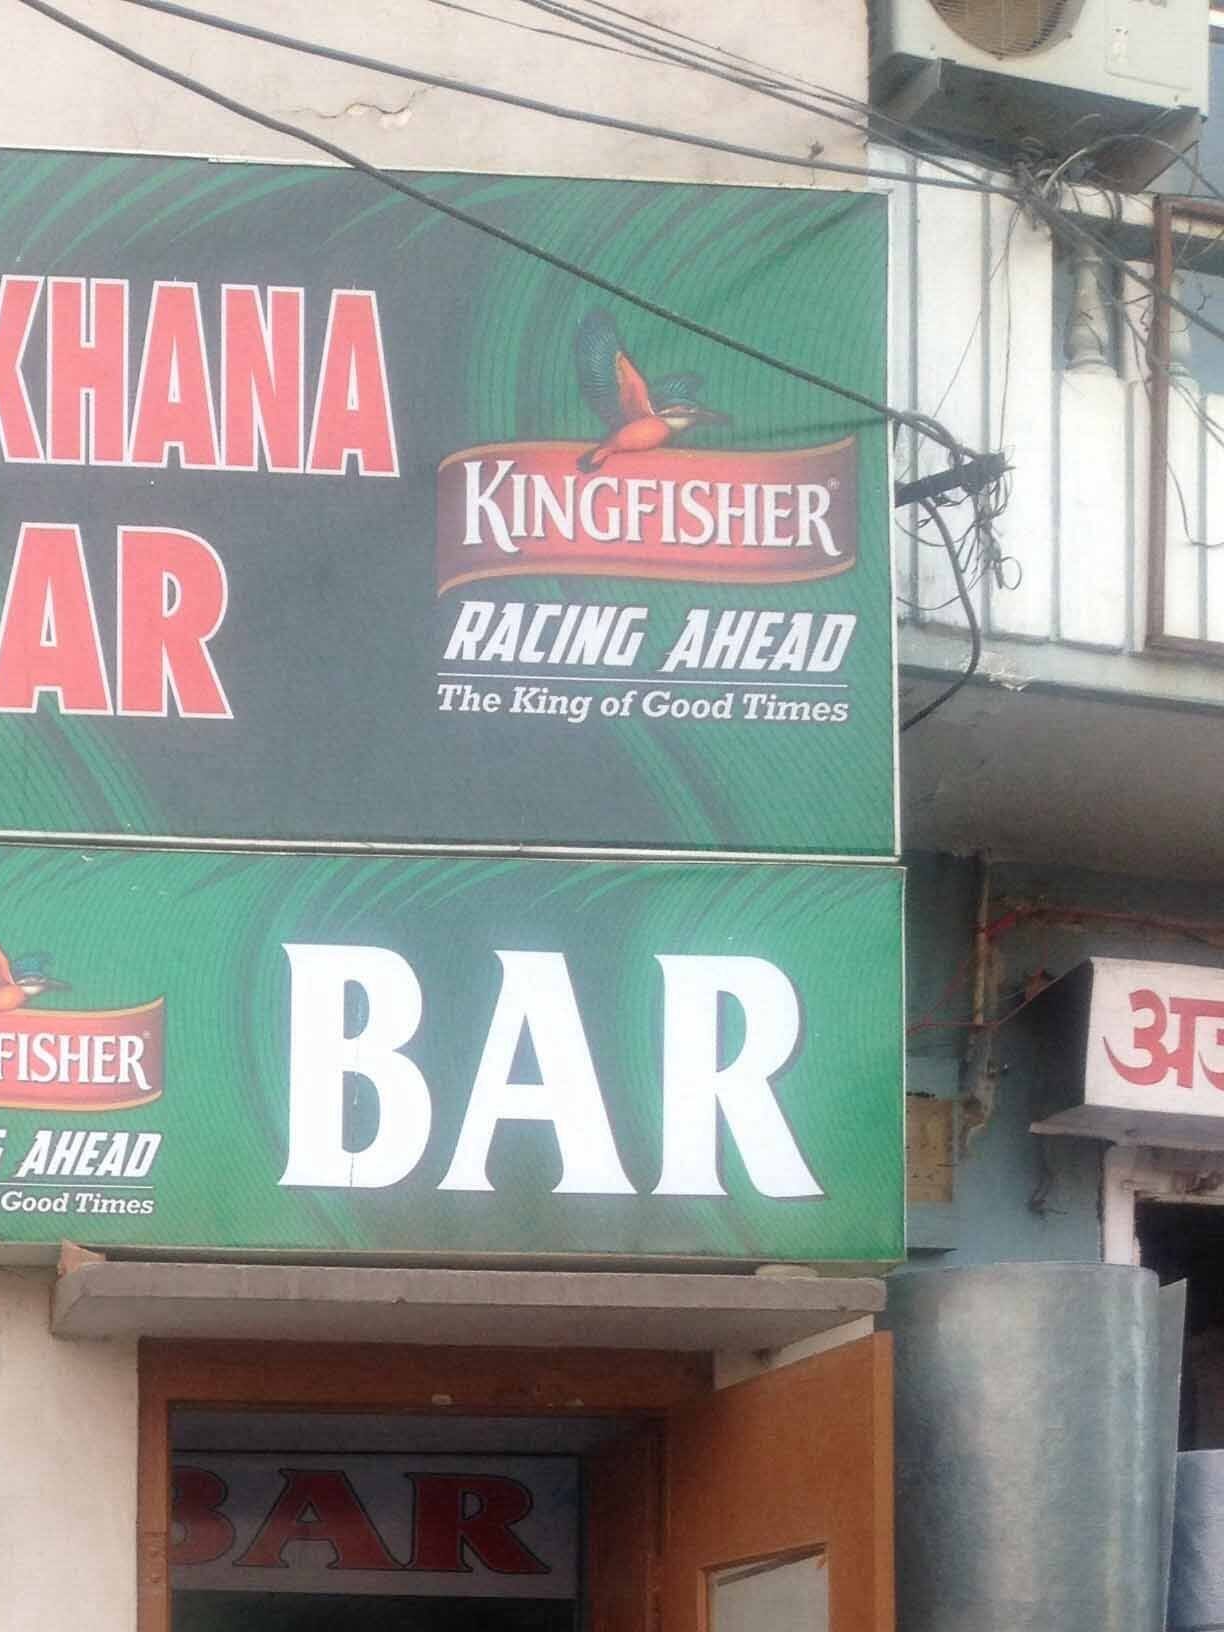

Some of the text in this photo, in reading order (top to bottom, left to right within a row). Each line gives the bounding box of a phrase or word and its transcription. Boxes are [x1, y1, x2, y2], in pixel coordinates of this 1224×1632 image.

[462, 460, 842, 557] KINGFISHER
[443, 600, 857, 673] RACING AHEAD
[437, 684, 849, 723] The King of Good Times
[276, 942, 825, 1198] BAR
[15, 1129, 162, 1178] AHEAD
[0, 1191, 69, 1214] Good
[75, 1194, 154, 1215] Times
[169, 1466, 552, 1575] BAR
